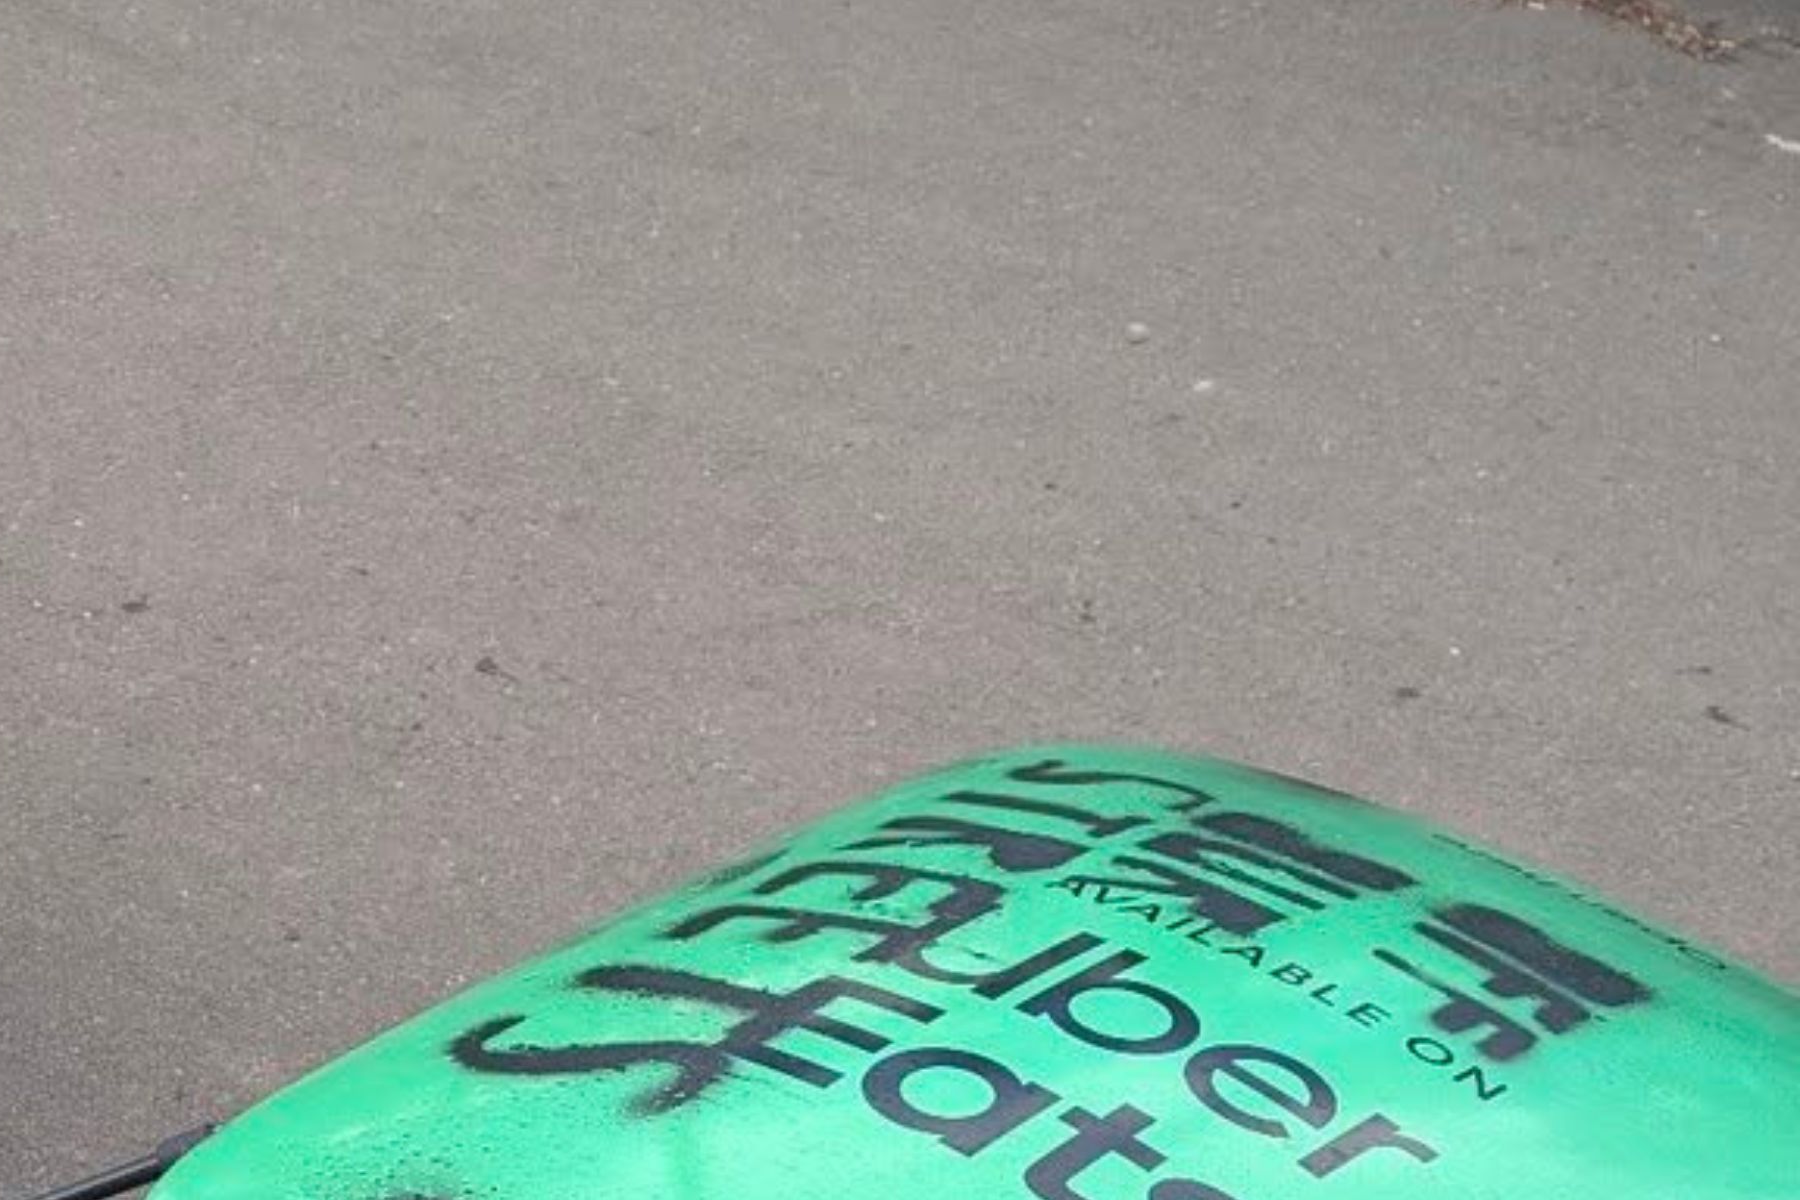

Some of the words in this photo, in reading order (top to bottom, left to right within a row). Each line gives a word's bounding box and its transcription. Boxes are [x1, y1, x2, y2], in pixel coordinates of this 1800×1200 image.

[903, 884, 1440, 1179] Uber
[1045, 872, 1393, 1031] AVAILABLE
[1405, 1035, 1508, 1102] ON
